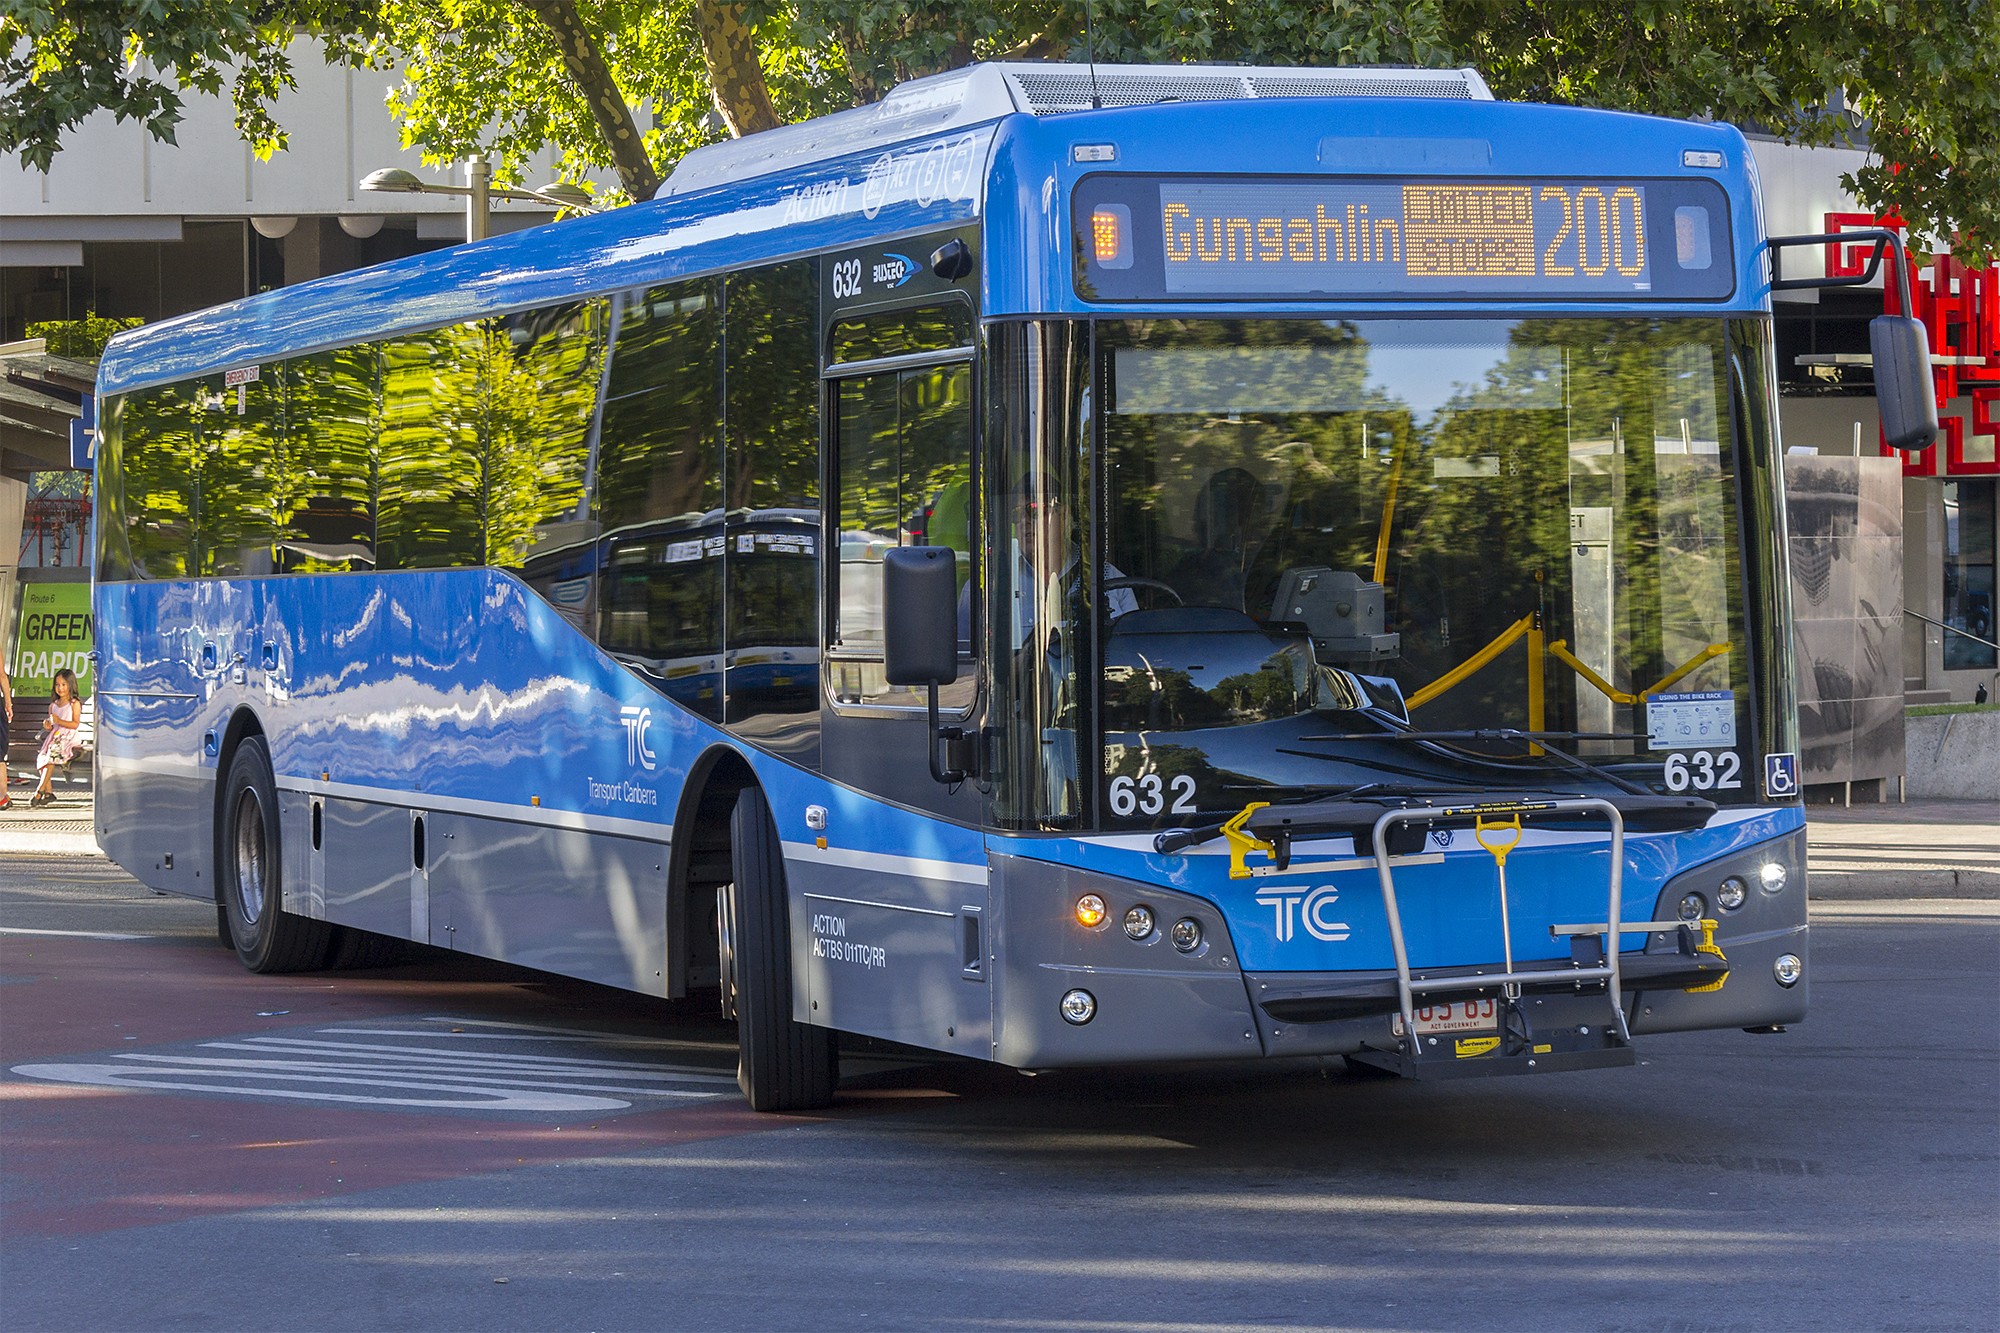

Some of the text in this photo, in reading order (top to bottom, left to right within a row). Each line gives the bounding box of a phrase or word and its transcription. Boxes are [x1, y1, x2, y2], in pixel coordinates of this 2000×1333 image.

[1164, 203, 1401, 262] Gungahlin
[1541, 187, 1645, 276] 200
[1422, 239, 1517, 271] STOPS
[833, 258, 862, 299] 632
[226, 366, 259, 385] EMERGENCY EXIT
[30, 594, 56, 604] Route 6
[26, 613, 95, 641] GREEN
[20, 651, 89, 679] RAPID
[1658, 693, 1679, 701] USING
[1691, 692, 1705, 700] BIKE
[620, 706, 656, 770] TC
[1664, 750, 1742, 792] 632
[587, 776, 657, 806] Transport Canberra
[1109, 774, 1197, 815] 632
[813, 914, 846, 937] ACTION
[1255, 885, 1350, 942] TC
[813, 937, 886, 970] ACTBS 011TC/RR
[1430, 1021, 1480, 1030] ACT GOVERNMENT
